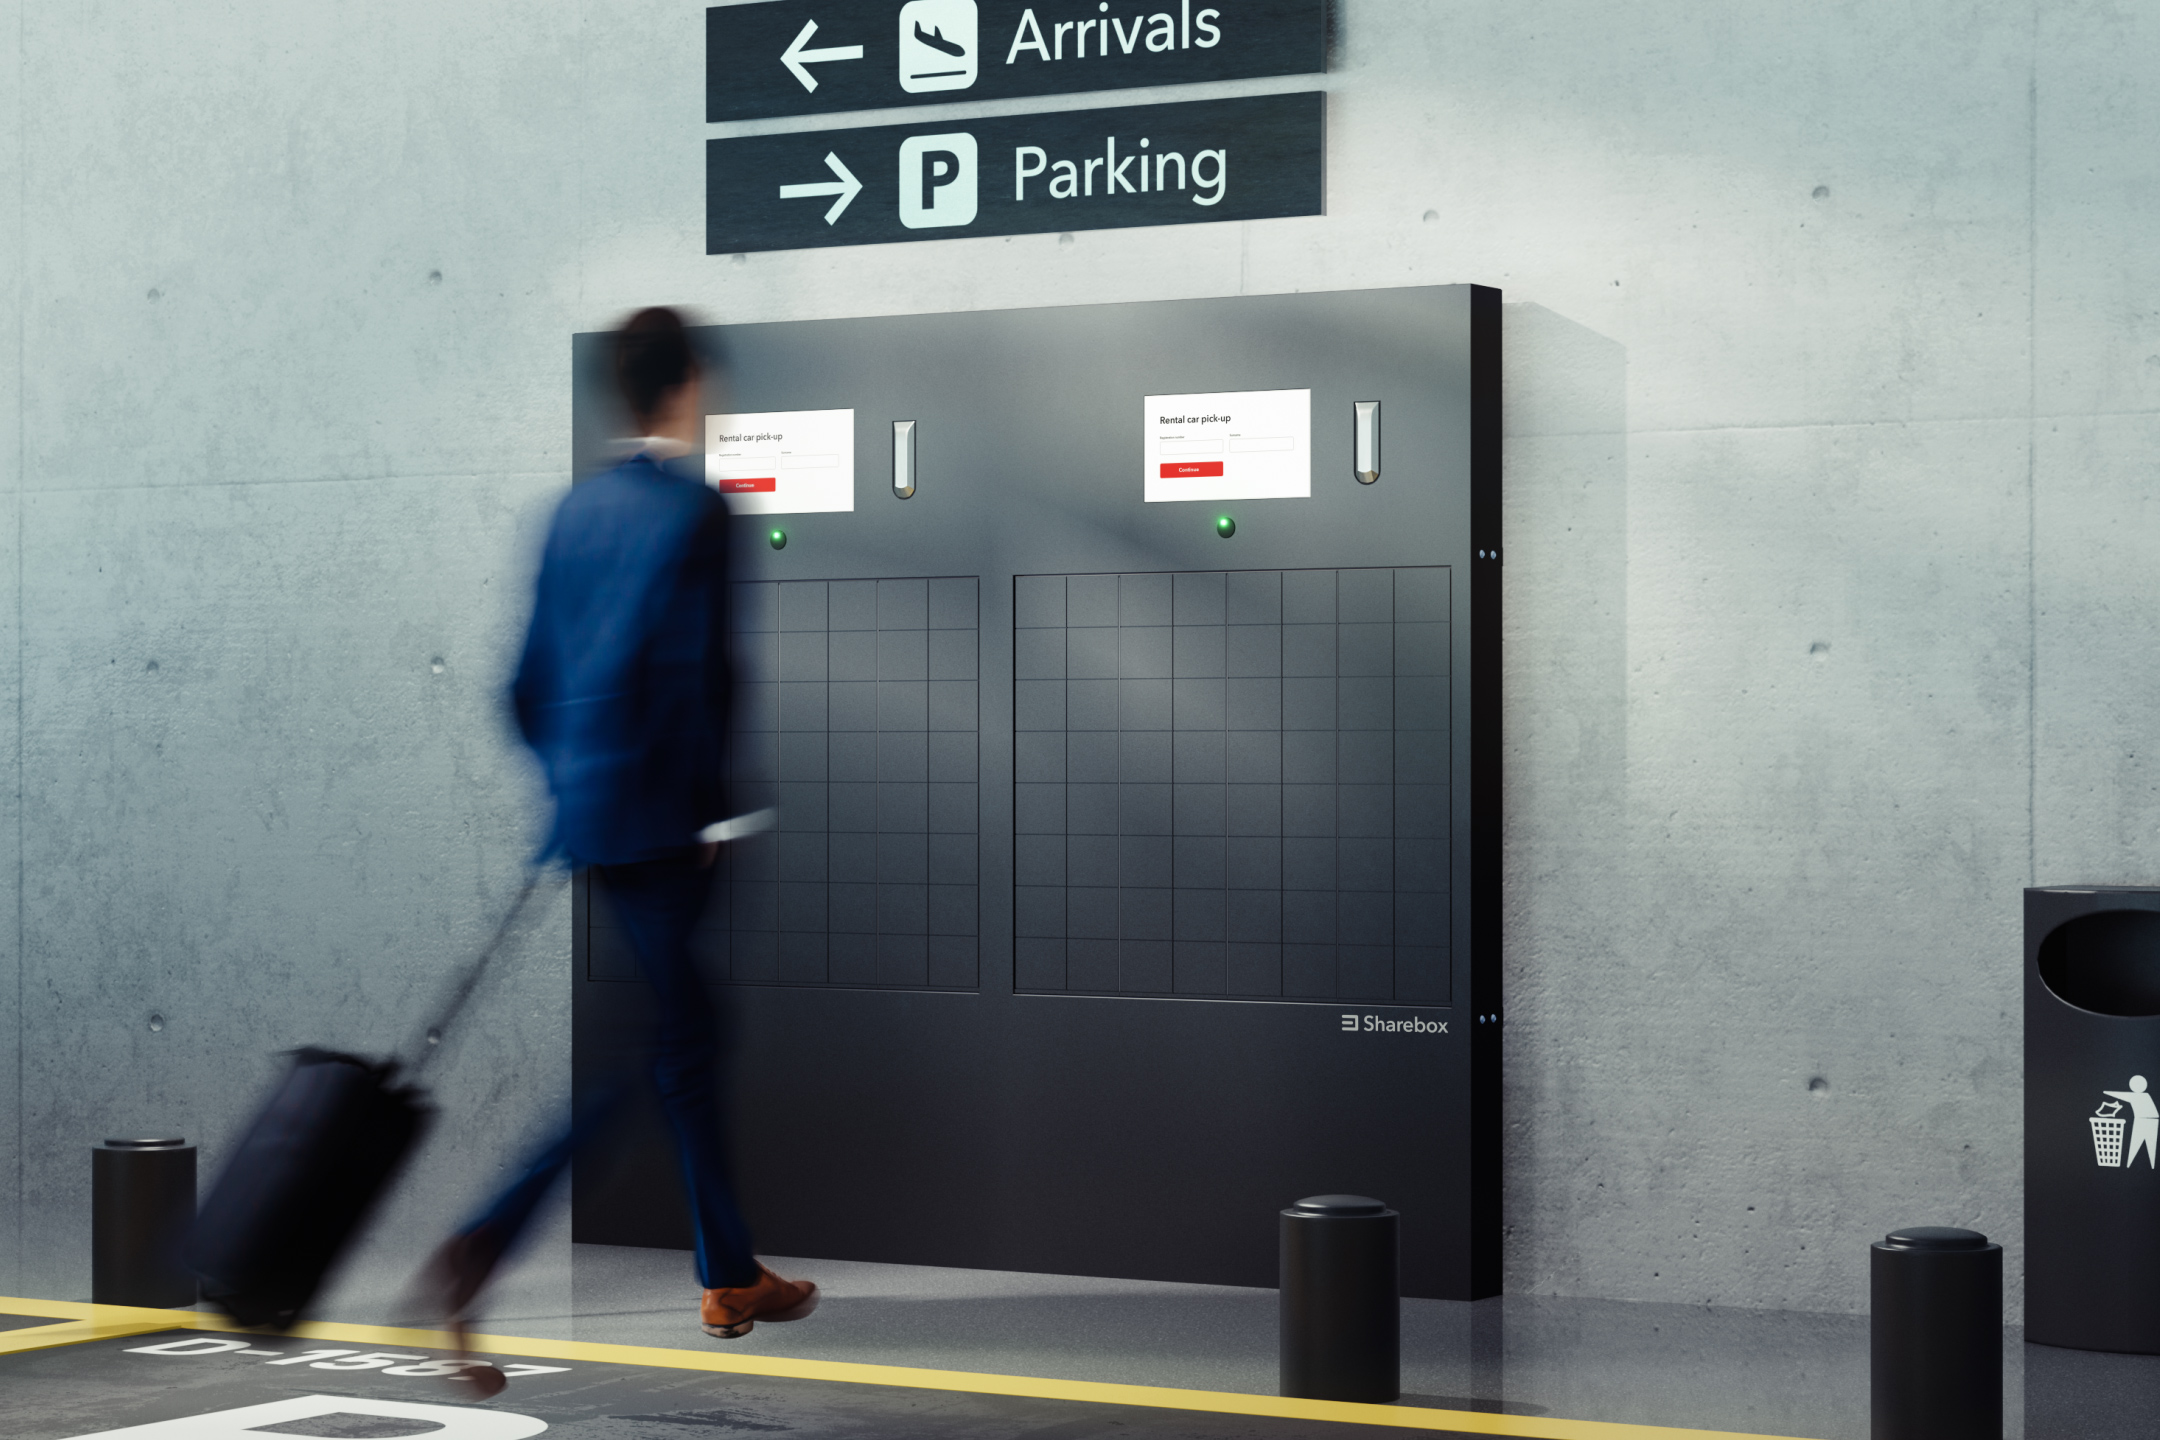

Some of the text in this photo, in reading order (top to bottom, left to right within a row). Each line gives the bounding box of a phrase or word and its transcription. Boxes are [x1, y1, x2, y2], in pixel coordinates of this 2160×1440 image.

[1006, 0, 1221, 64] Arrivals
[922, 151, 960, 210] P
[1015, 137, 1226, 206] Parking
[719, 433, 742, 443] Rental
[756, 432, 783, 443] pick-up
[1159, 414, 1232, 425] Rental car pick-up
[1363, 1015, 1449, 1034] Sharebox
[122, 1338, 573, 1381] D-1587
